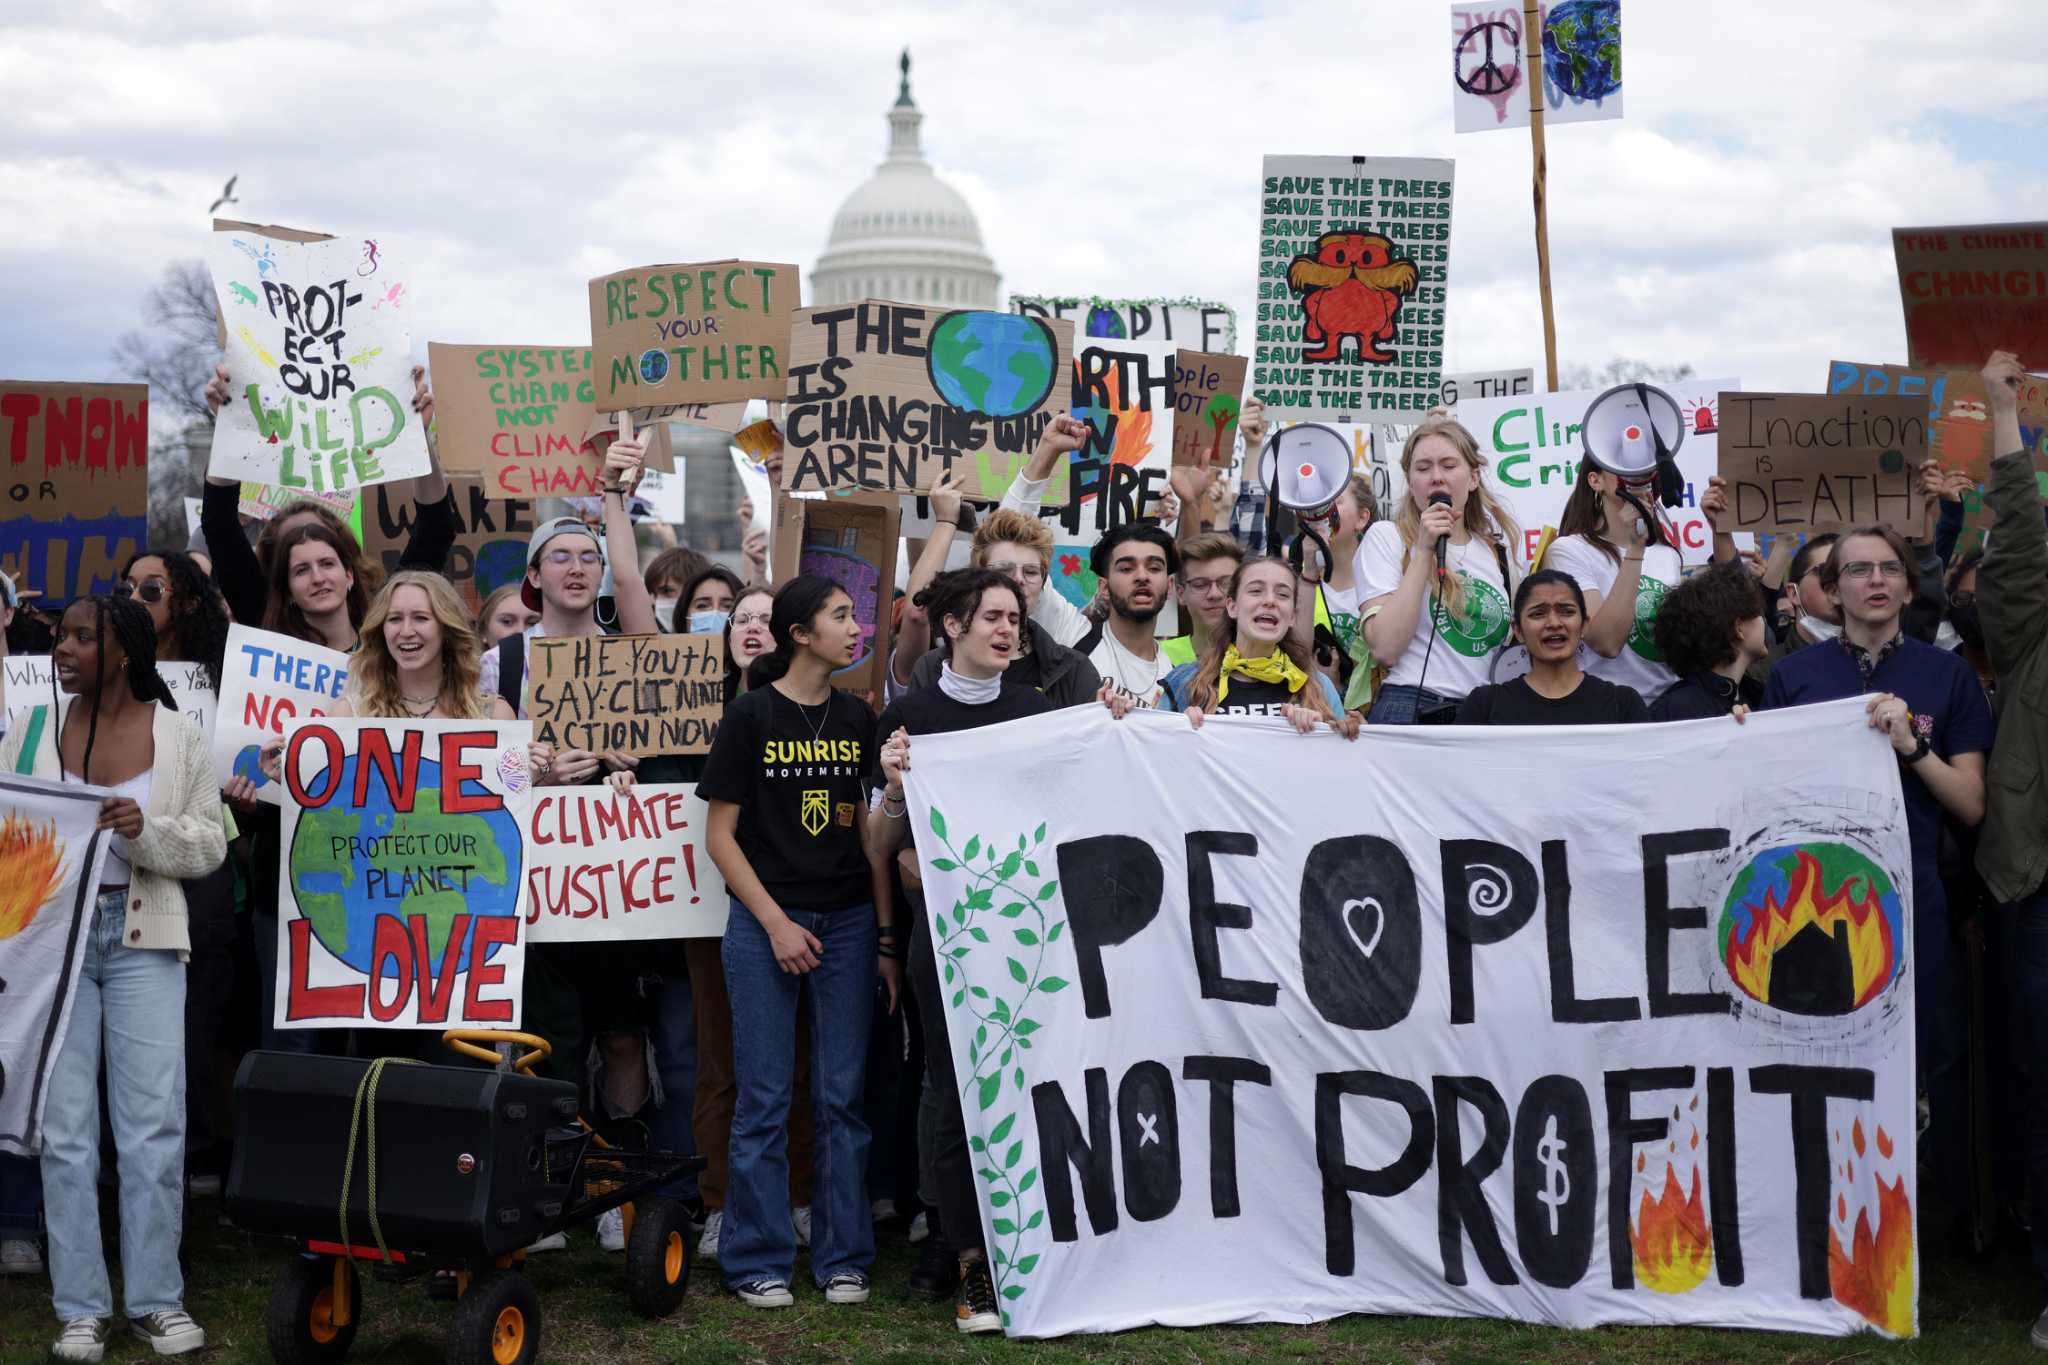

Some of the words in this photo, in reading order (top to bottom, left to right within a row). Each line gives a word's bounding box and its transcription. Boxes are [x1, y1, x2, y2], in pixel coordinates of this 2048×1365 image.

[1264, 176, 1325, 196] SAVE
[1328, 177, 1374, 197] THE
[1379, 178, 1451, 199] TREES
[1263, 197, 1323, 216] SAVE
[1328, 199, 1373, 217] THE
[1377, 200, 1450, 219] TREES
[1262, 218, 1322, 237] SAVE
[1376, 221, 1449, 241] TREES
[1903, 233, 1948, 251] THE
[1962, 230, 2047, 250] CLIMATE
[606, 267, 777, 327] RESPECT
[283, 327, 347, 365] ECT
[655, 317, 719, 341] YOUR
[811, 304, 927, 357] THE
[1256, 324, 1302, 342] SAV
[610, 345, 780, 395] MOTHER
[1255, 346, 1301, 364] SAV
[279, 364, 356, 400] OUR
[489, 379, 596, 404] CHANG
[788, 358, 853, 403] IS
[1254, 367, 1314, 386] SAVE
[1318, 369, 1364, 387] THE
[1368, 370, 1441, 389] TREES
[495, 404, 560, 428] NOT
[1253, 389, 1312, 408] SAVE
[1317, 391, 1362, 409] THE
[1367, 392, 1440, 411] TREES
[44, 396, 148, 480] NOW
[786, 399, 988, 454] CHANGING
[993, 411, 1064, 454] WH
[1731, 397, 1924, 451] Inaction
[498, 464, 603, 495] CHAN
[790, 442, 963, 490] AREN'T
[9, 481, 57, 501] OR
[1068, 459, 1167, 536] FIRE
[1735, 472, 1913, 527] DEATH
[535, 637, 619, 680] THE
[537, 718, 650, 752] ACTION
[762, 739, 862, 764] SUNRISE
[285, 724, 504, 814] ONE
[765, 766, 859, 778] MOVEMENT
[531, 791, 689, 848] CLIMATE
[331, 832, 429, 861] PROTECT
[435, 832, 477, 857] OUR
[366, 864, 476, 900] PLANET
[1055, 827, 1732, 1031] PEOPLE
[286, 913, 520, 1025] LOVE
[1030, 1055, 1272, 1243] NOT
[1314, 1063, 1876, 1300] PROFIT
